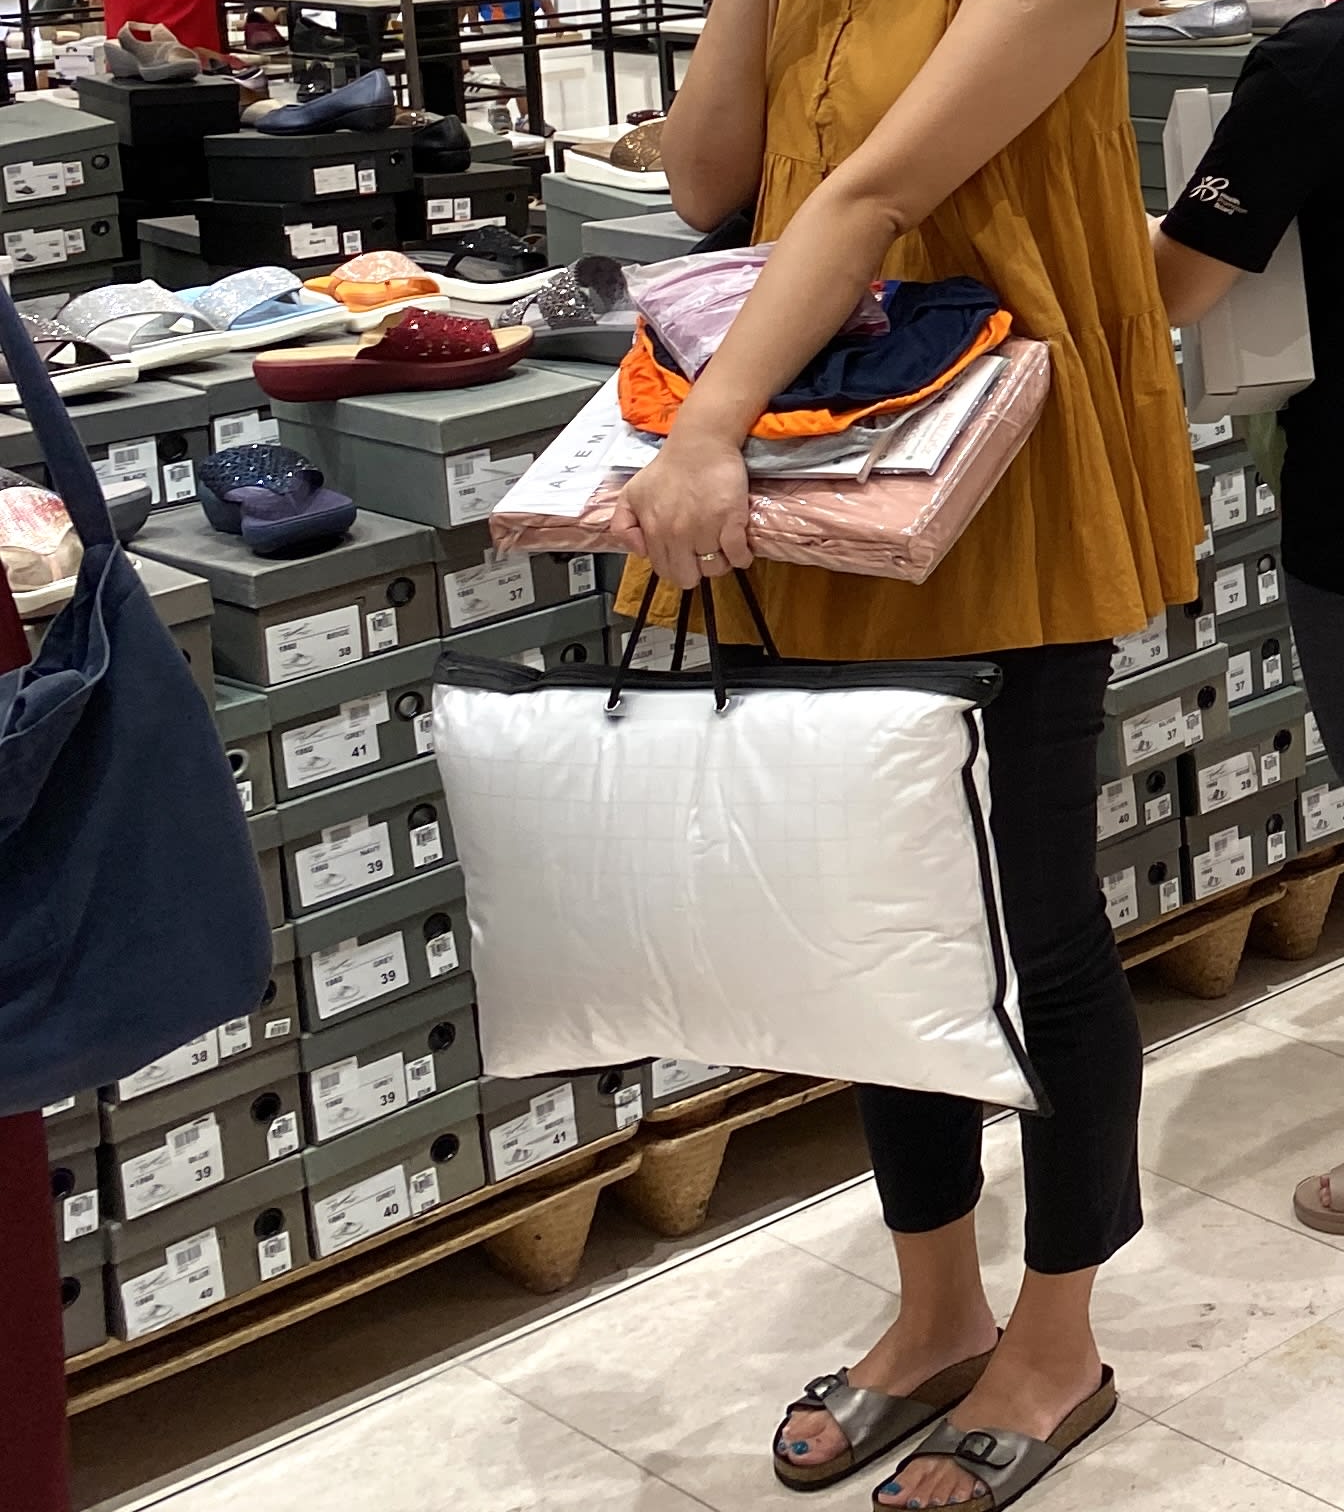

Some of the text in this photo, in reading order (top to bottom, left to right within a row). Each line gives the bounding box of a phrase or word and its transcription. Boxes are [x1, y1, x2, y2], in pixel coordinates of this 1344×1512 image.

[548, 423, 616, 489] AKEMI
[509, 587, 523, 602] 37
[1228, 591, 1239, 604] 37
[1150, 644, 1161, 658] 39
[1235, 680, 1246, 693] 37
[1166, 727, 1178, 741] 37
[351, 744, 368, 758] 41
[1118, 812, 1130, 825] 40
[367, 859, 384, 875] 39
[1235, 866, 1246, 878] 40
[1118, 906, 1131, 919] 41
[380, 969, 396, 985] 39
[191, 1050, 208, 1066] 38
[379, 1091, 396, 1107] 39
[552, 1131, 567, 1145] 41
[194, 1166, 212, 1182] 39
[383, 1202, 399, 1218] 40
[200, 1287, 214, 1300] 40
